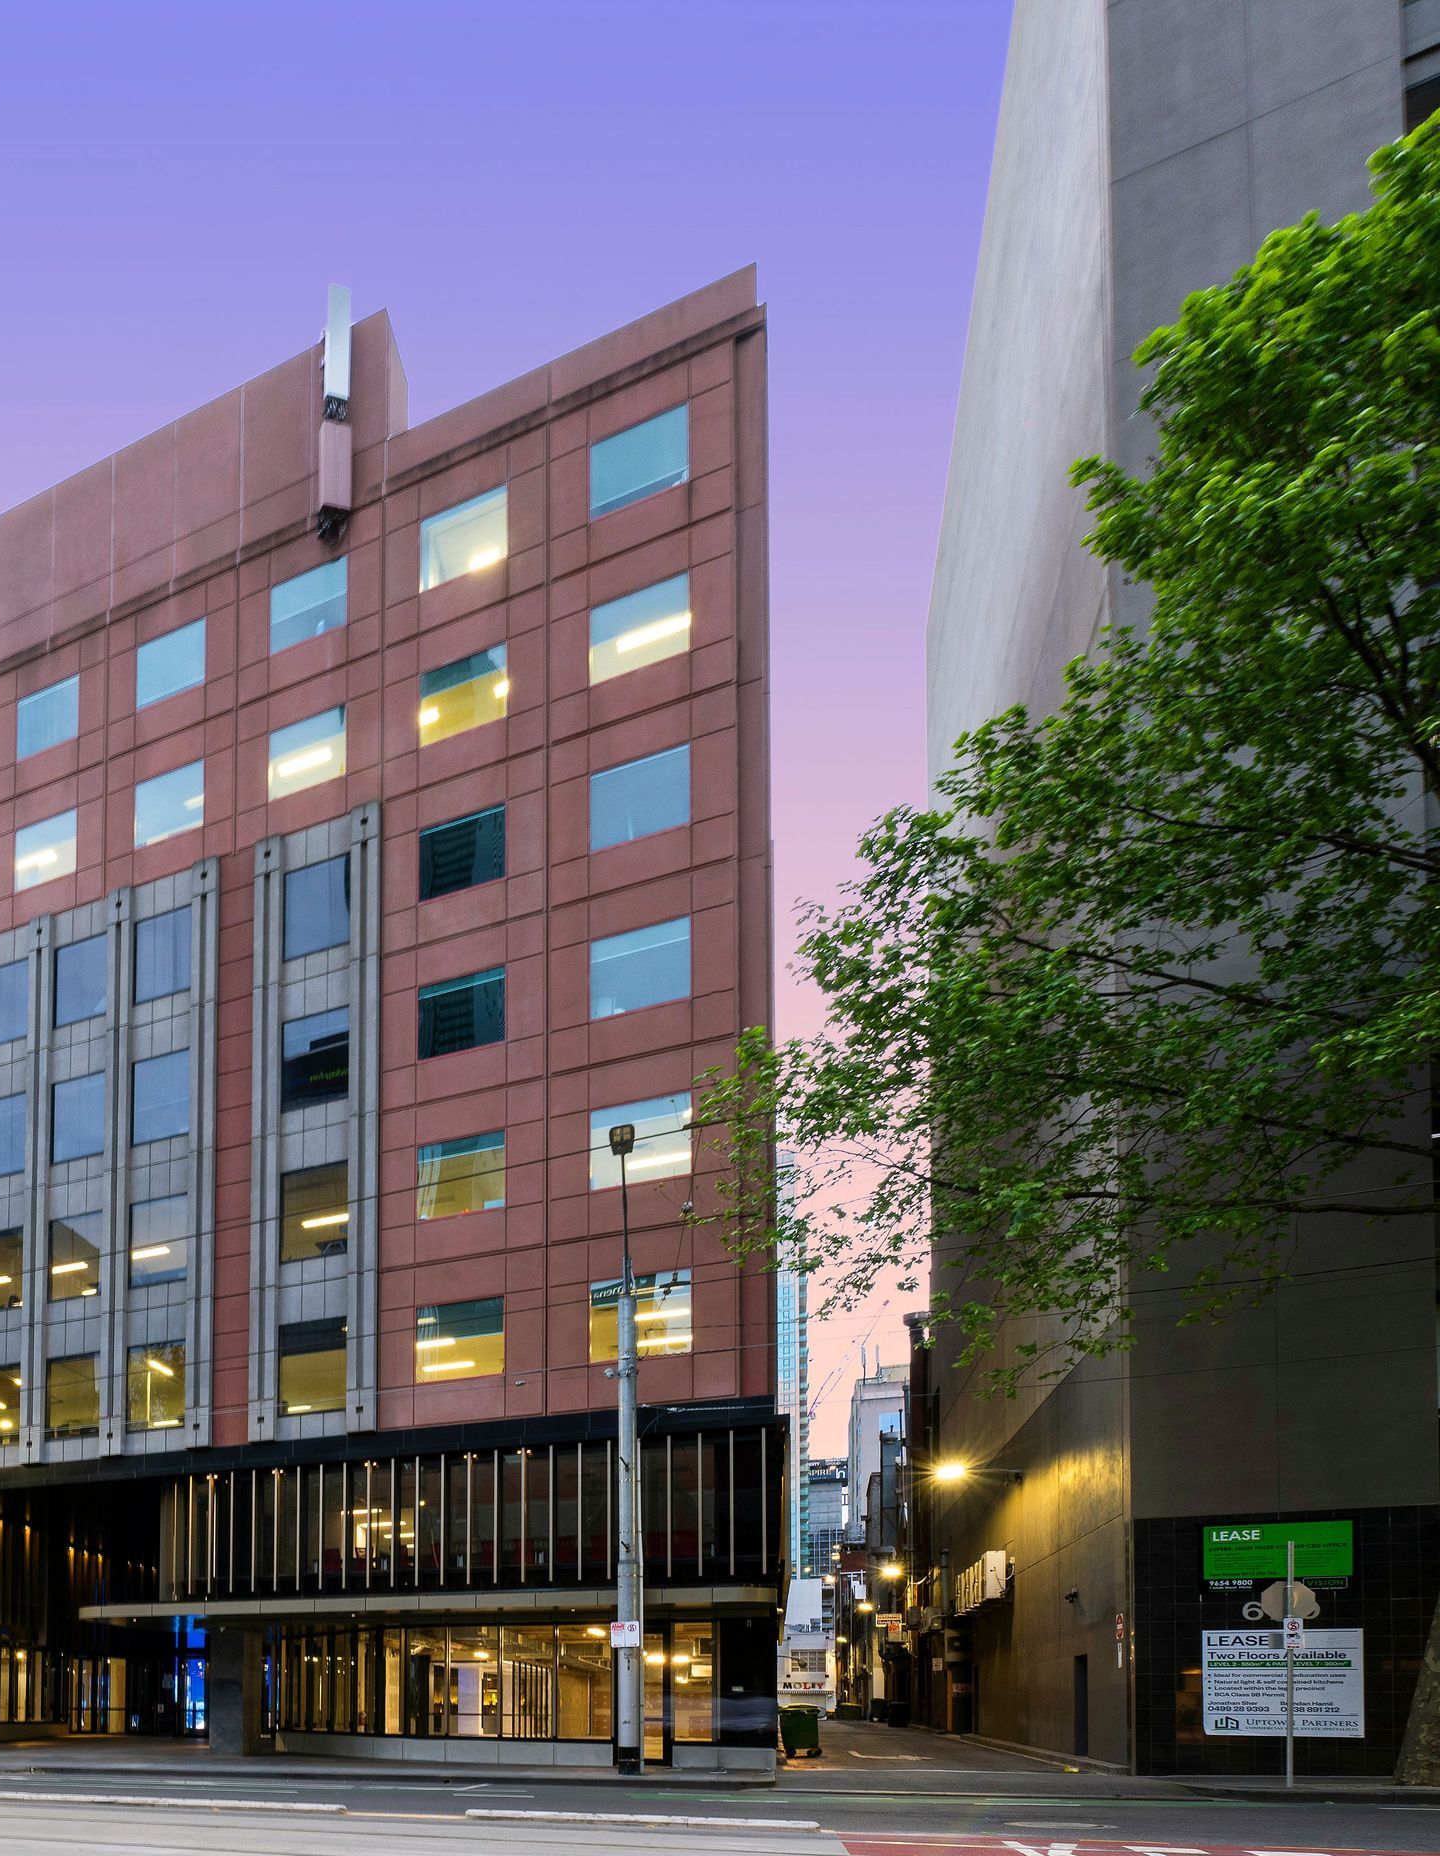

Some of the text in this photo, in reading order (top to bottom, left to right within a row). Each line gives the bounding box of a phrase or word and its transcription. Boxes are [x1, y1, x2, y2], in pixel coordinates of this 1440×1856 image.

[1212, 1529, 1261, 1542] LEASE
[1306, 1579, 1344, 1587] VISION
[1207, 1635, 1269, 1647] LEASE
[1207, 1652, 1235, 1660] Two
[1238, 1651, 1280, 1660] Floors
[1246, 1718, 1359, 1727] UPTOW PARTNERS
